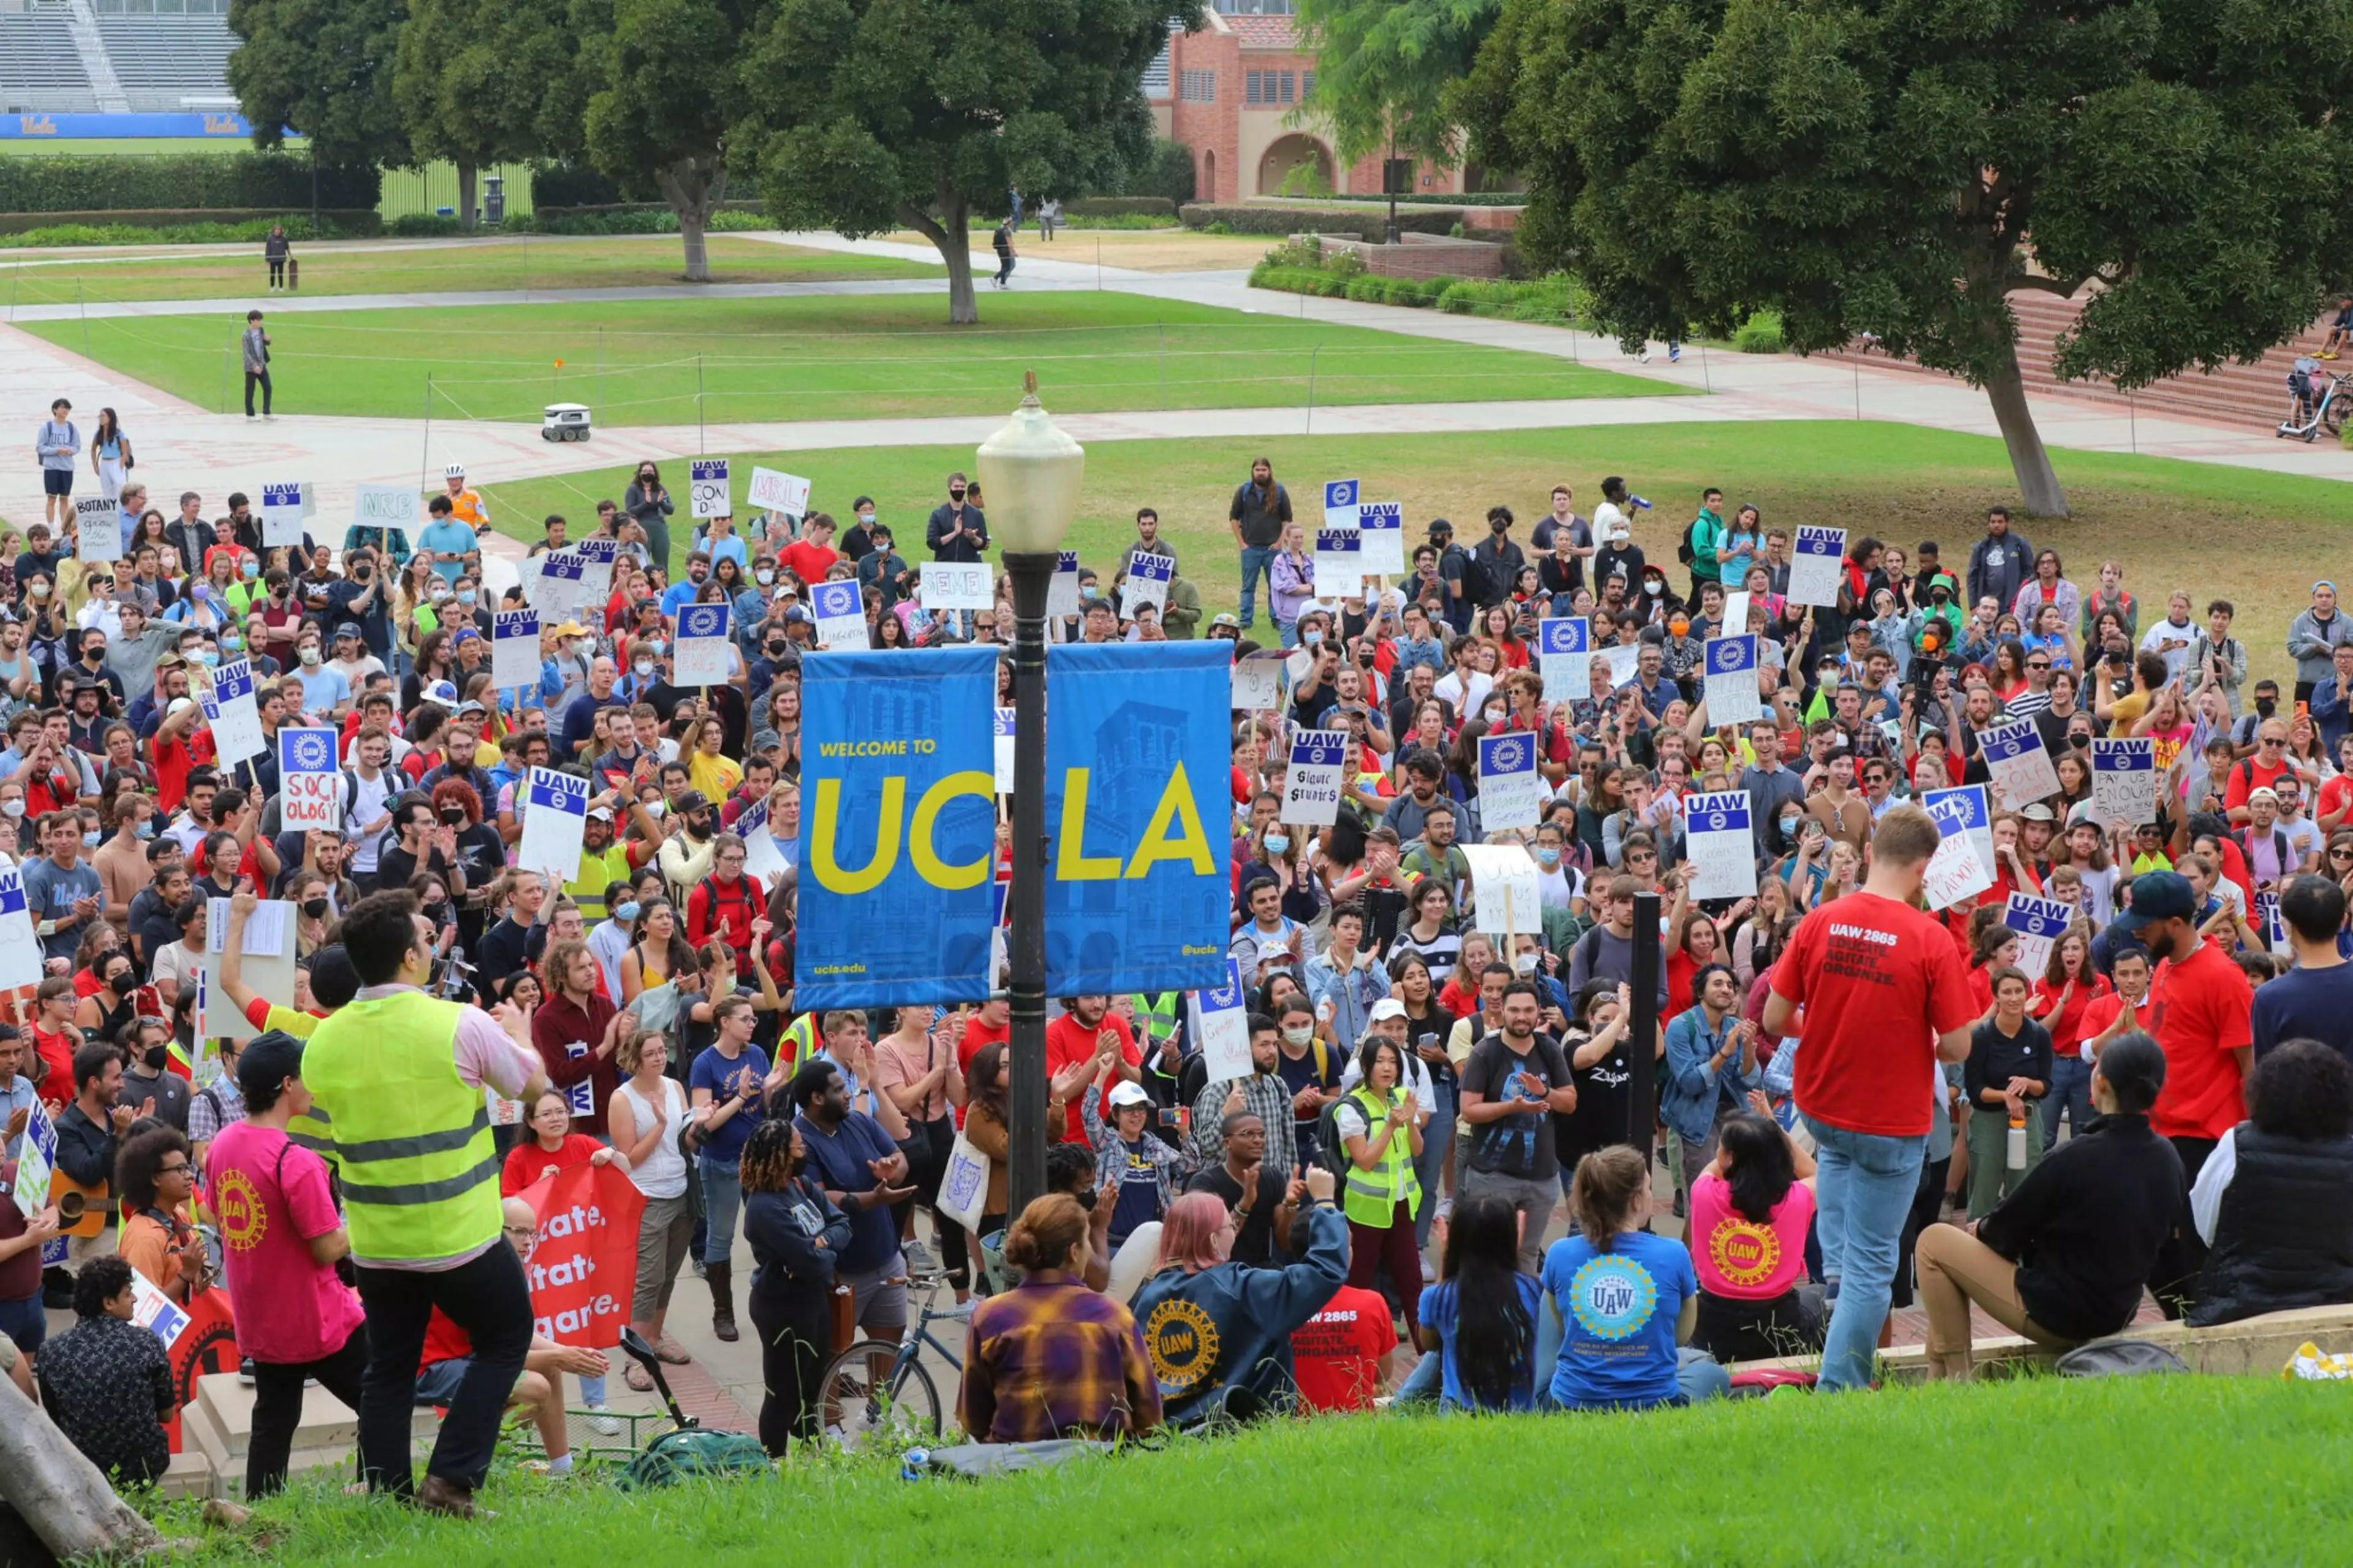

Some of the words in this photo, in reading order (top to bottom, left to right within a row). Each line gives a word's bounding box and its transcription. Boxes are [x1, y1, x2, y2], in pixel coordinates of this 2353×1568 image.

[692, 461, 727, 470] UAW
[263, 483, 300, 494] UAW
[691, 483, 726, 501] GON
[77, 499, 118, 513] BOTANY
[700, 500, 718, 513] DA
[1360, 504, 1399, 515] UAW
[84, 520, 113, 536] grow
[1318, 529, 1359, 539] UAW
[1800, 528, 1843, 542] UAW
[578, 540, 617, 553] UAW
[547, 552, 586, 567] UAW
[1134, 553, 1171, 569] UAW
[921, 571, 993, 596] SEMEL
[496, 609, 539, 624] UAW
[212, 661, 249, 684] UAW
[1296, 733, 1346, 748] UAW
[1980, 721, 2031, 746] UAW
[304, 748, 319, 756] UAW
[819, 740, 907, 757] WELCOME
[913, 739, 936, 754] TO
[2094, 740, 2150, 754] UAW
[1500, 750, 1515, 760] UAW
[535, 768, 586, 795] UAW
[1297, 770, 1331, 785] Slavic
[2098, 771, 2120, 784] PAY
[2129, 771, 2146, 784] US
[287, 773, 337, 801] SOCI
[2096, 783, 2154, 805] ENOUGH
[1688, 794, 1745, 812] UAW
[2096, 806, 2111, 816] TO
[2112, 804, 2131, 814] LIVE
[286, 801, 338, 825] OLOGY
[1945, 832, 1967, 855] PAY
[1934, 855, 1980, 903] LABOR
[2011, 895, 2069, 920] UAW
[1830, 923, 1863, 939] UAW
[1863, 928, 1898, 946] 2865
[1183, 944, 1217, 956] @ucla
[814, 963, 866, 975] ucla.edu
[1728, 1241, 1760, 1260] UAW
[1594, 1287, 1633, 1315] UAW
[1324, 1310, 1358, 1323] 2865
[1161, 1331, 1194, 1356] UAW
